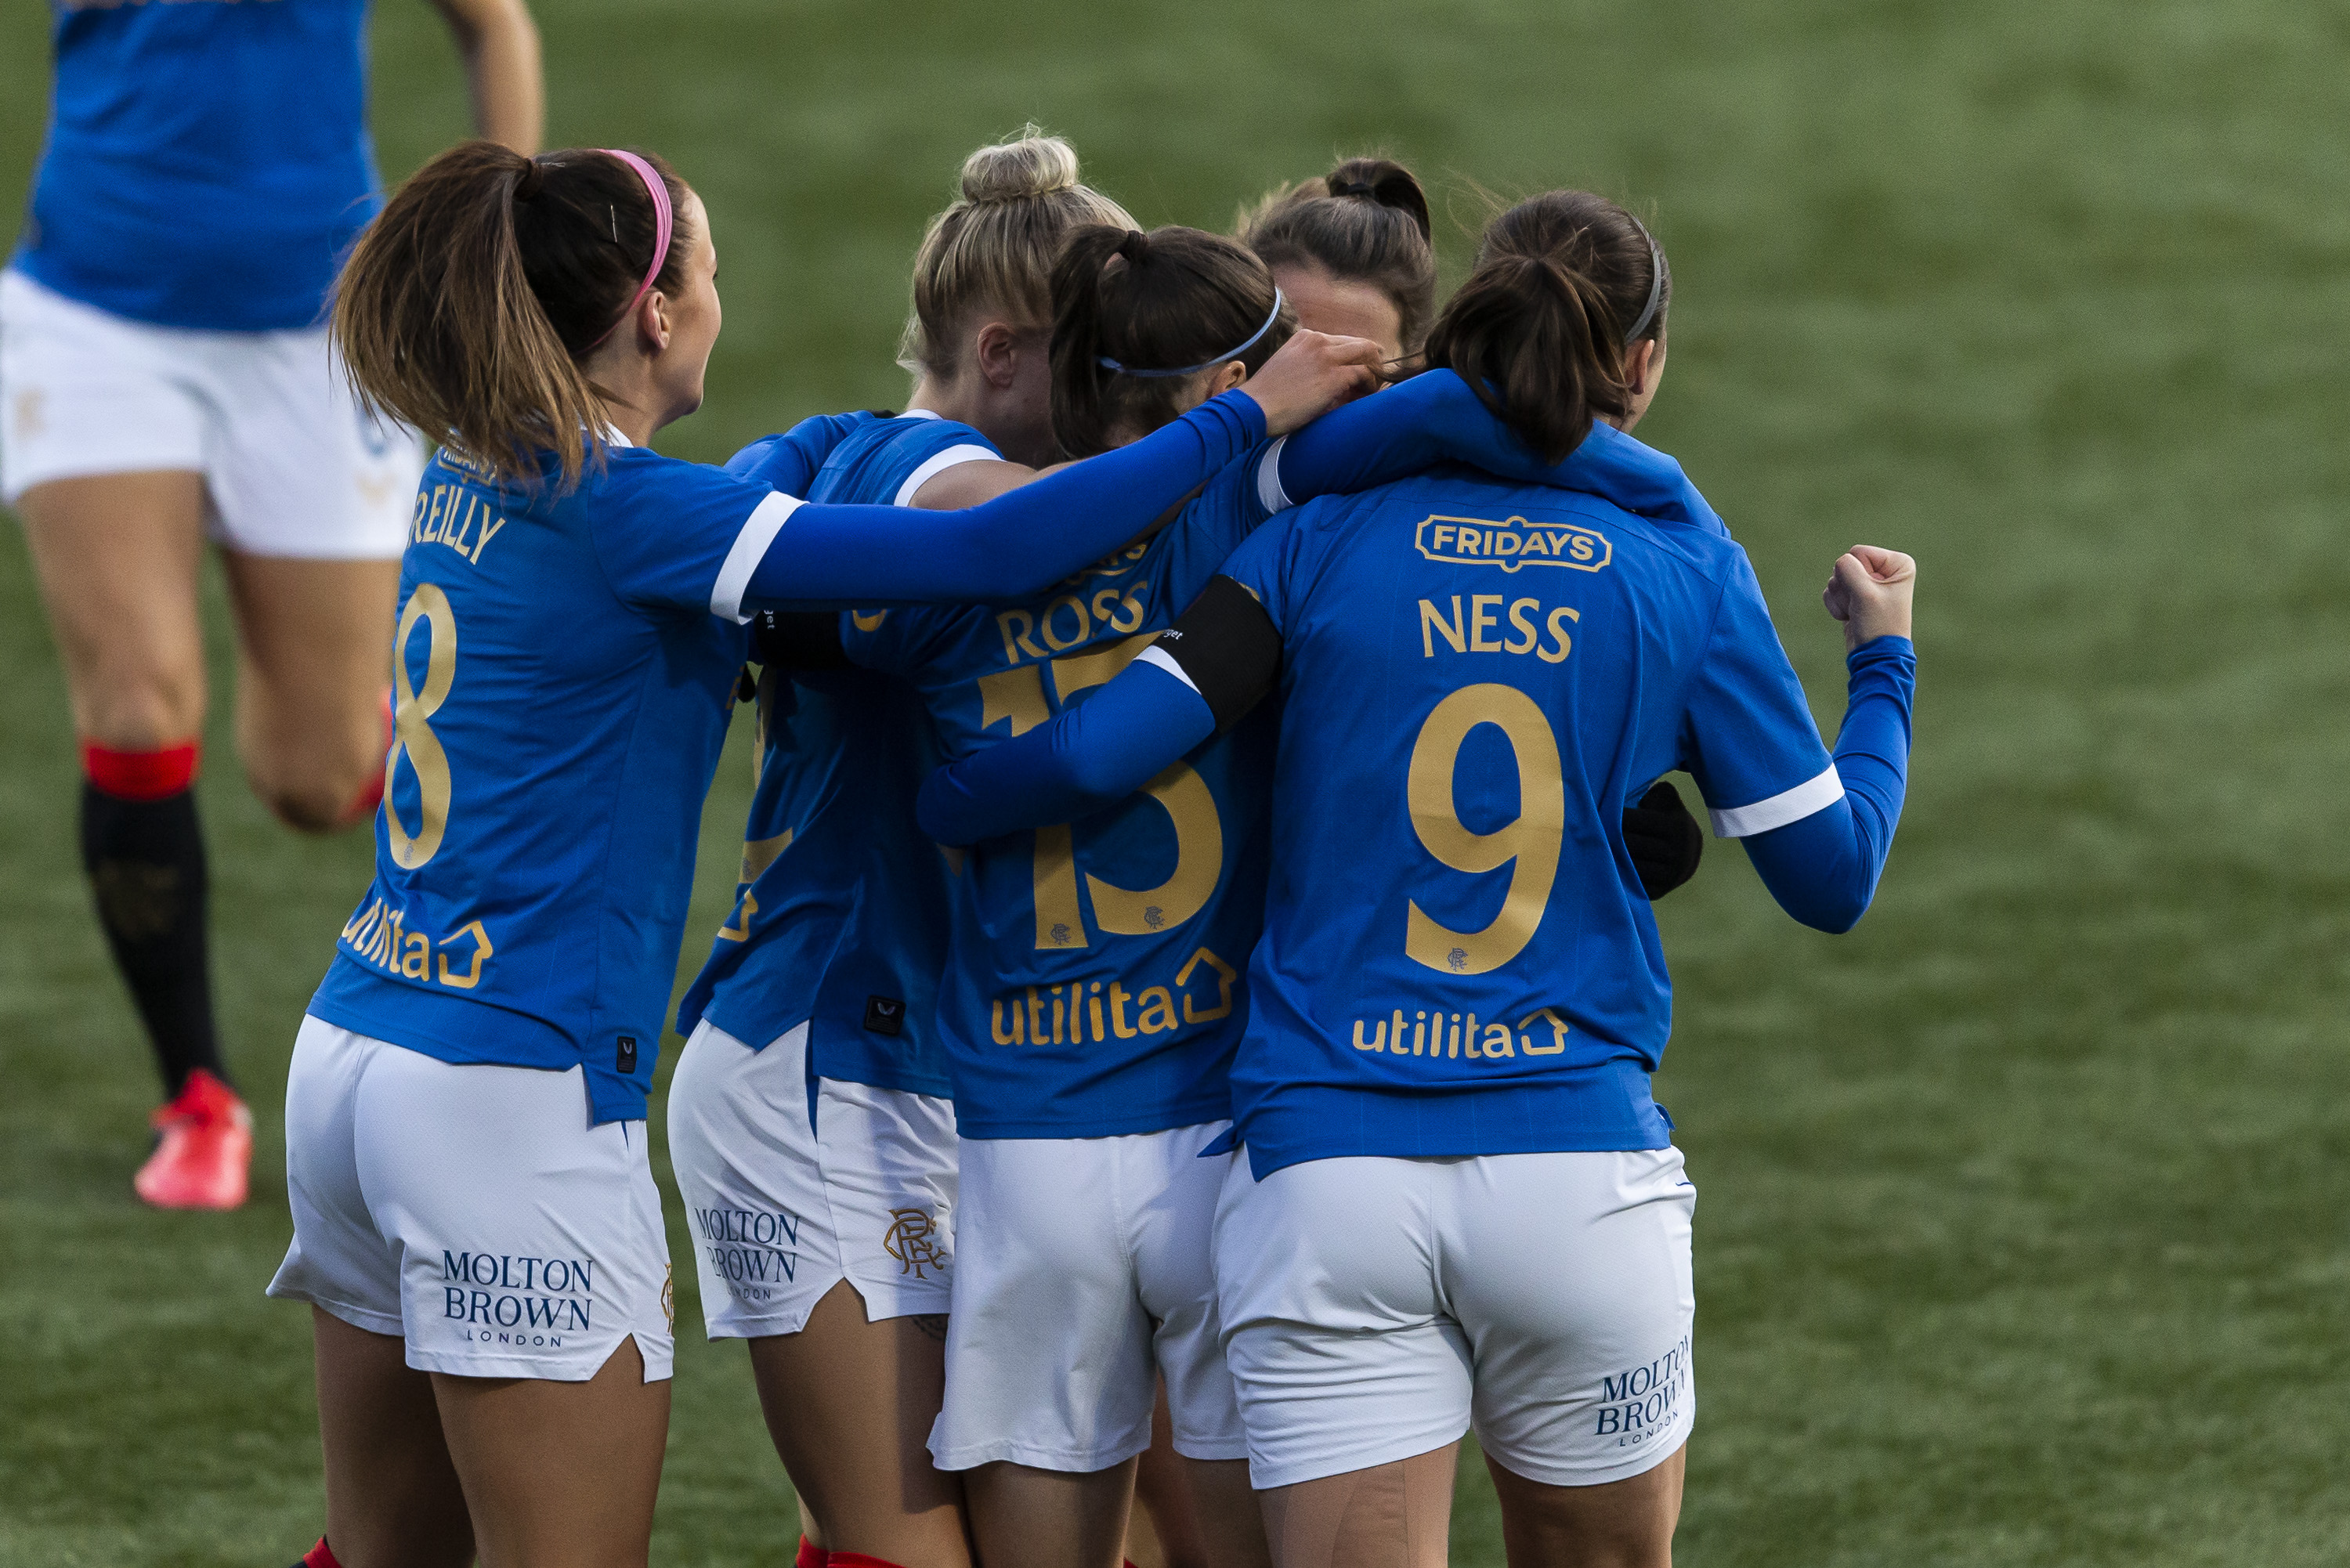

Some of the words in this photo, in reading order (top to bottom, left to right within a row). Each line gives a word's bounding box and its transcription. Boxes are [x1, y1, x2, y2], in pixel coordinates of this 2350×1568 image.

[1433, 525, 1596, 561] FRIDAYS
[996, 580, 1141, 665] ROSS
[1418, 594, 1581, 664] NESS
[385, 583, 457, 870] 8
[1406, 682, 1565, 975] 9
[991, 981, 1179, 1046] utilita
[1352, 1009, 1516, 1059] utilita
[442, 1249, 594, 1292] MOLTON
[443, 1285, 593, 1331] BROWN
[467, 1328, 562, 1348] LONDON
[1618, 1409, 1679, 1447] LONDON
